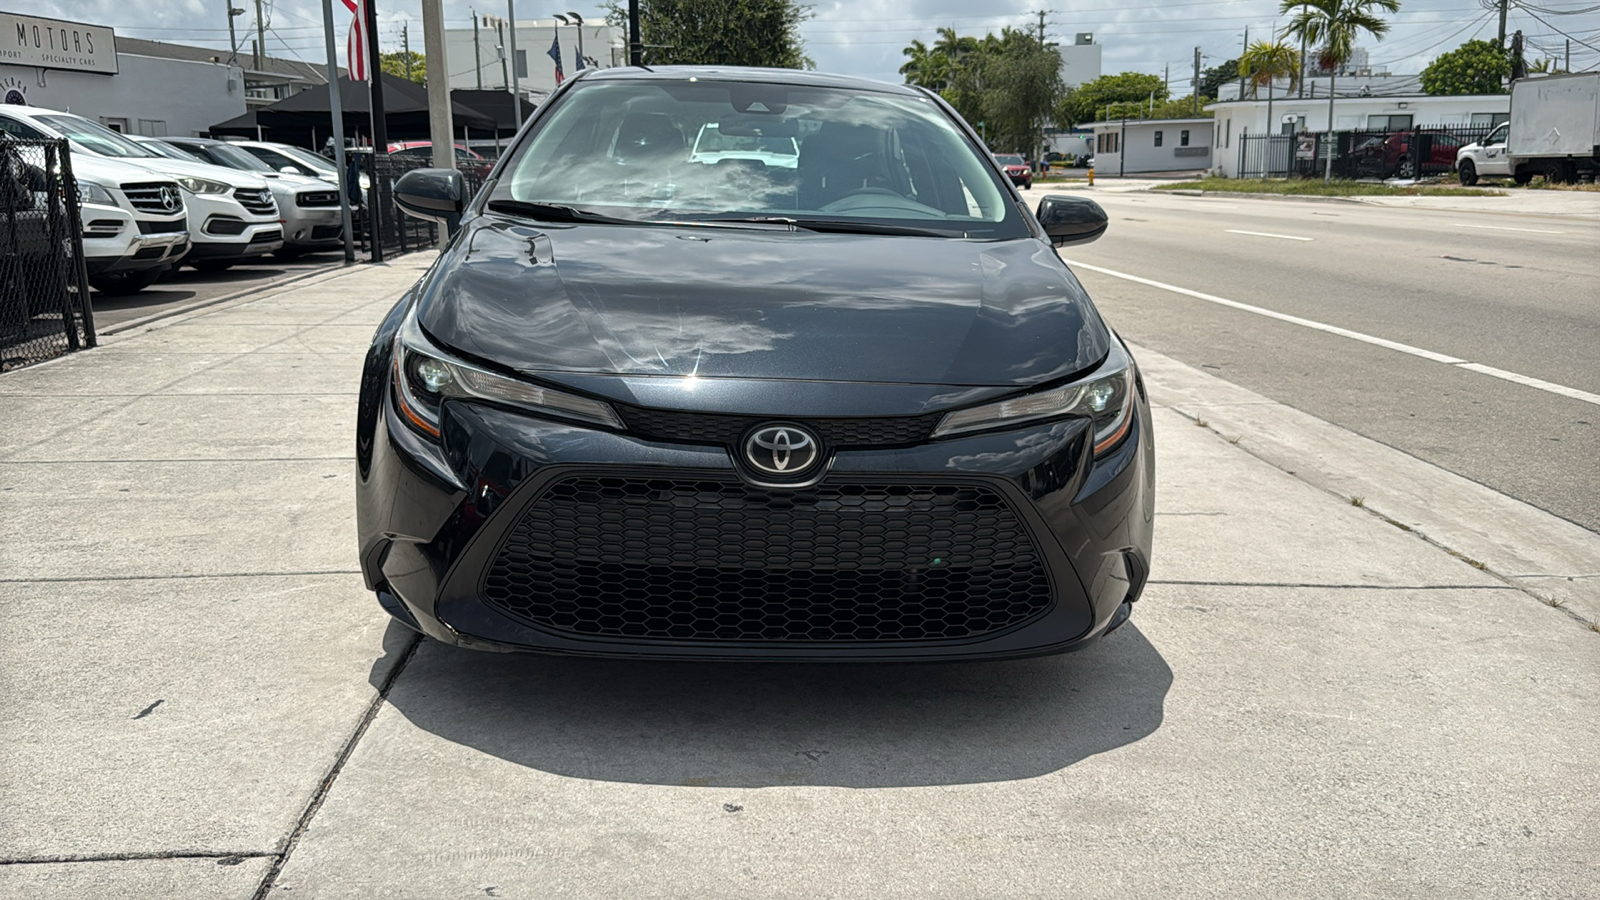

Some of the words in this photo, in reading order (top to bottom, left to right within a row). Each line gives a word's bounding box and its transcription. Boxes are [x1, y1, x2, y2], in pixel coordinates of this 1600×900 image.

[16, 22, 94, 54] MOTORS
[41, 54, 76, 63] SPECIALTY
[79, 58, 95, 66] CARS
